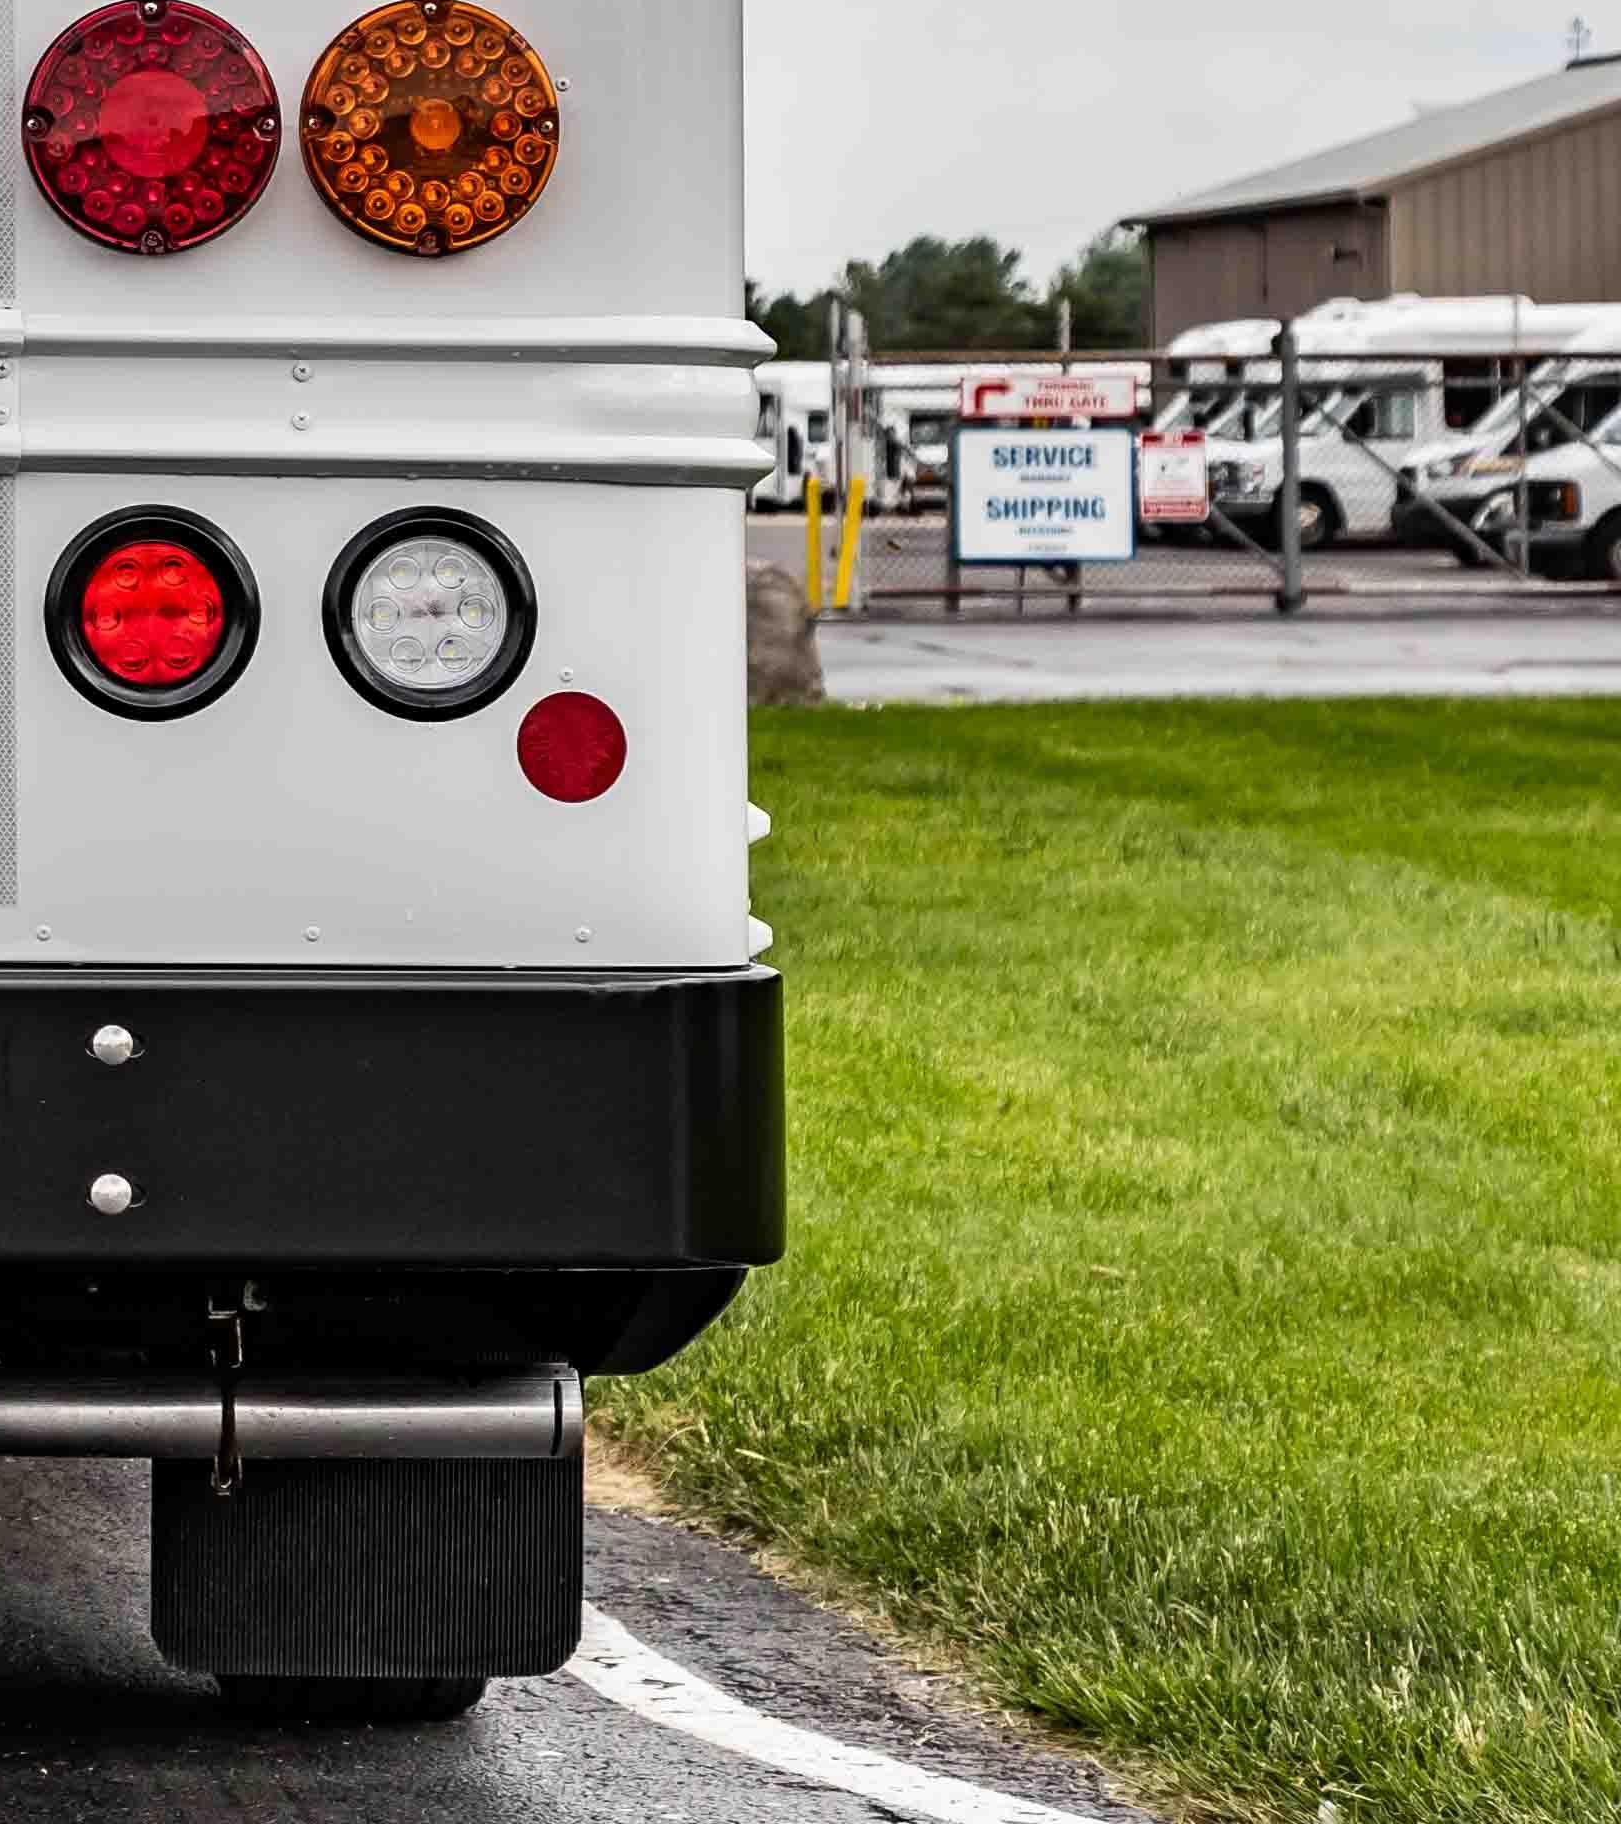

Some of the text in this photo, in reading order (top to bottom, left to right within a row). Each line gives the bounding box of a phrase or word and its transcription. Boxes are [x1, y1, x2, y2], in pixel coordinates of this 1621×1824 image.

[1069, 394, 1109, 409] GATE
[992, 445, 1096, 468] SERVICE
[986, 496, 1107, 520] SHIPPING
